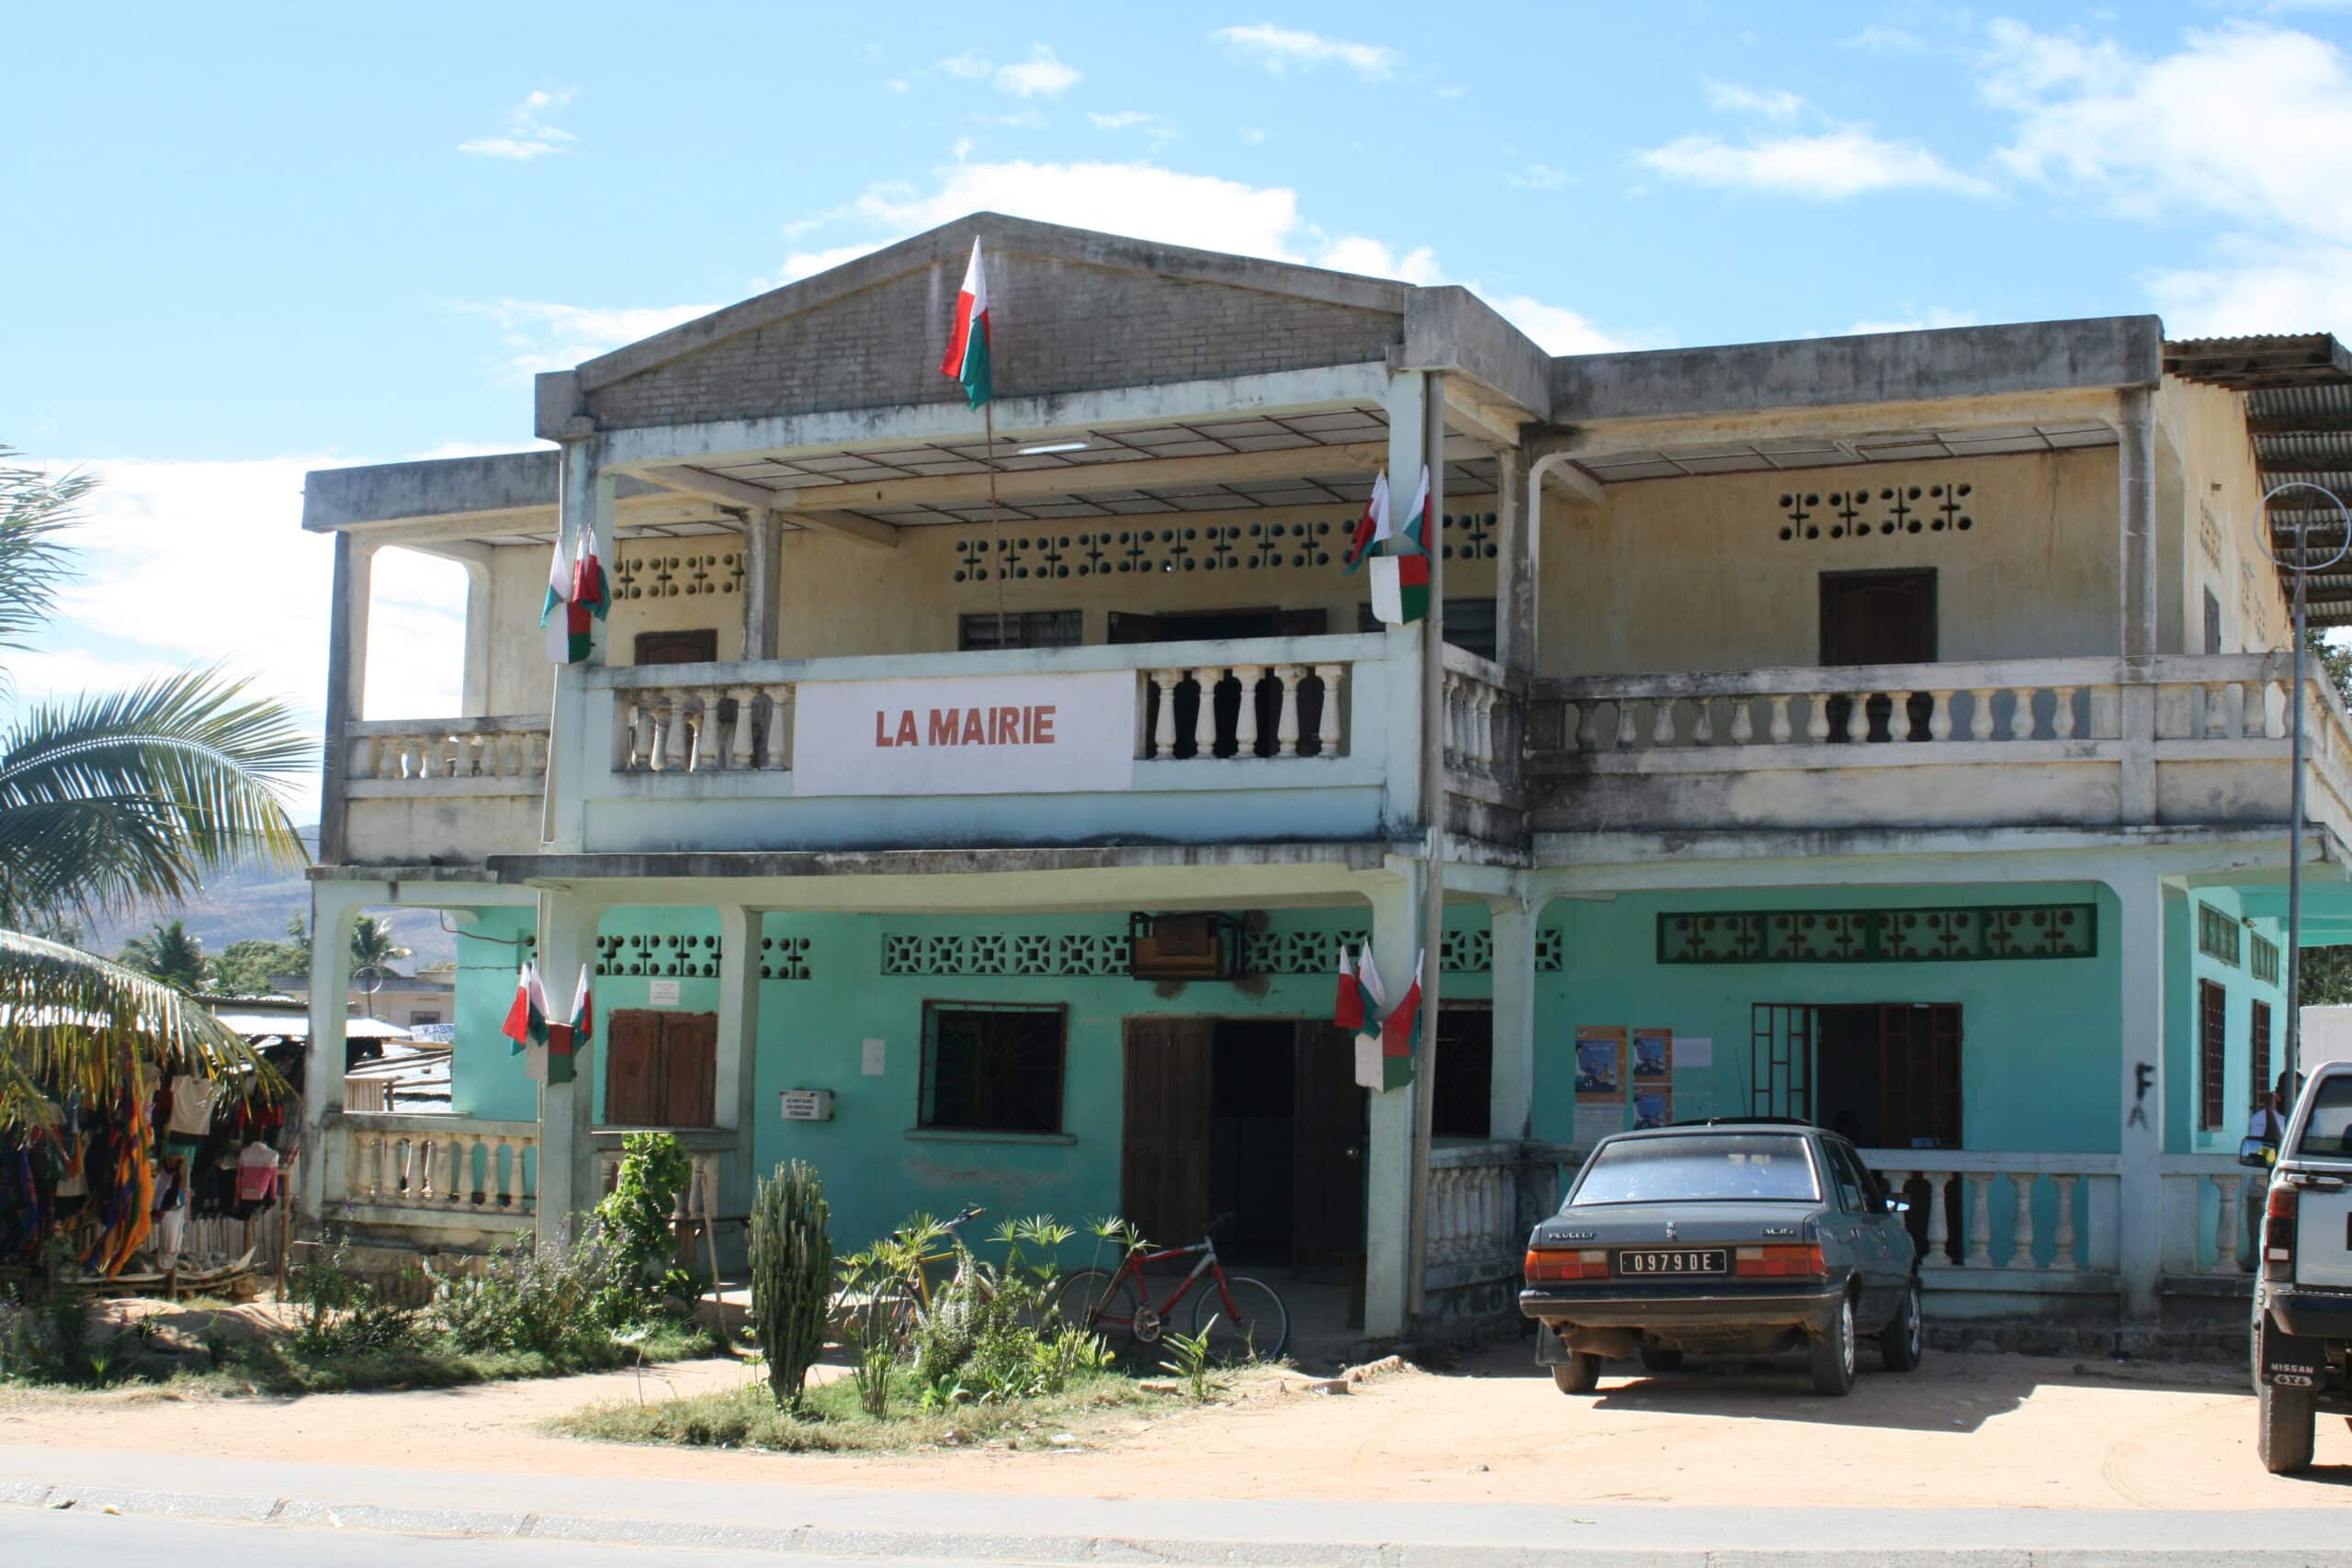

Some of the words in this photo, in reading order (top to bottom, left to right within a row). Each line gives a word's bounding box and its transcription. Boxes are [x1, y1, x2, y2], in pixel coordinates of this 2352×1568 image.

[876, 709, 919, 748] LA
[928, 705, 1057, 747] MAIRIE
[2270, 1362, 2315, 1375] NISSAN
